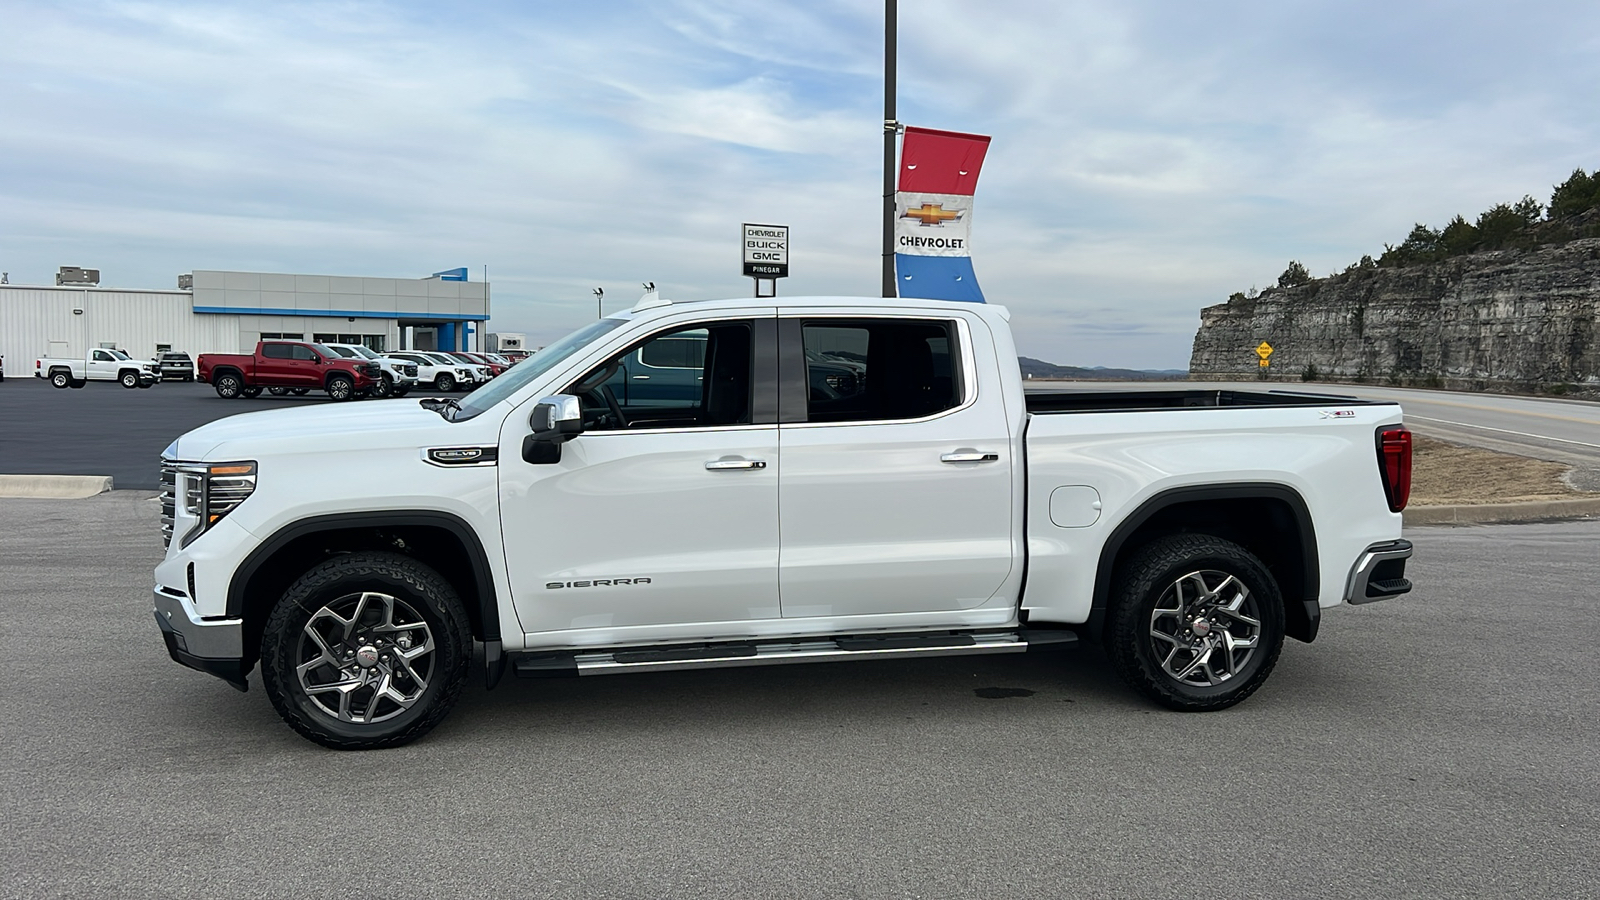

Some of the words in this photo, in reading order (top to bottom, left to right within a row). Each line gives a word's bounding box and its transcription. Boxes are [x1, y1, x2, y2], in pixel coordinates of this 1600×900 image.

[747, 229, 785, 238] CHEVROLET
[747, 240, 785, 250] BUICK
[899, 235, 963, 248] CHEVROLET
[752, 252, 781, 261] GMC
[752, 265, 780, 273] PINEGAR
[545, 577, 652, 590] SIERRA
